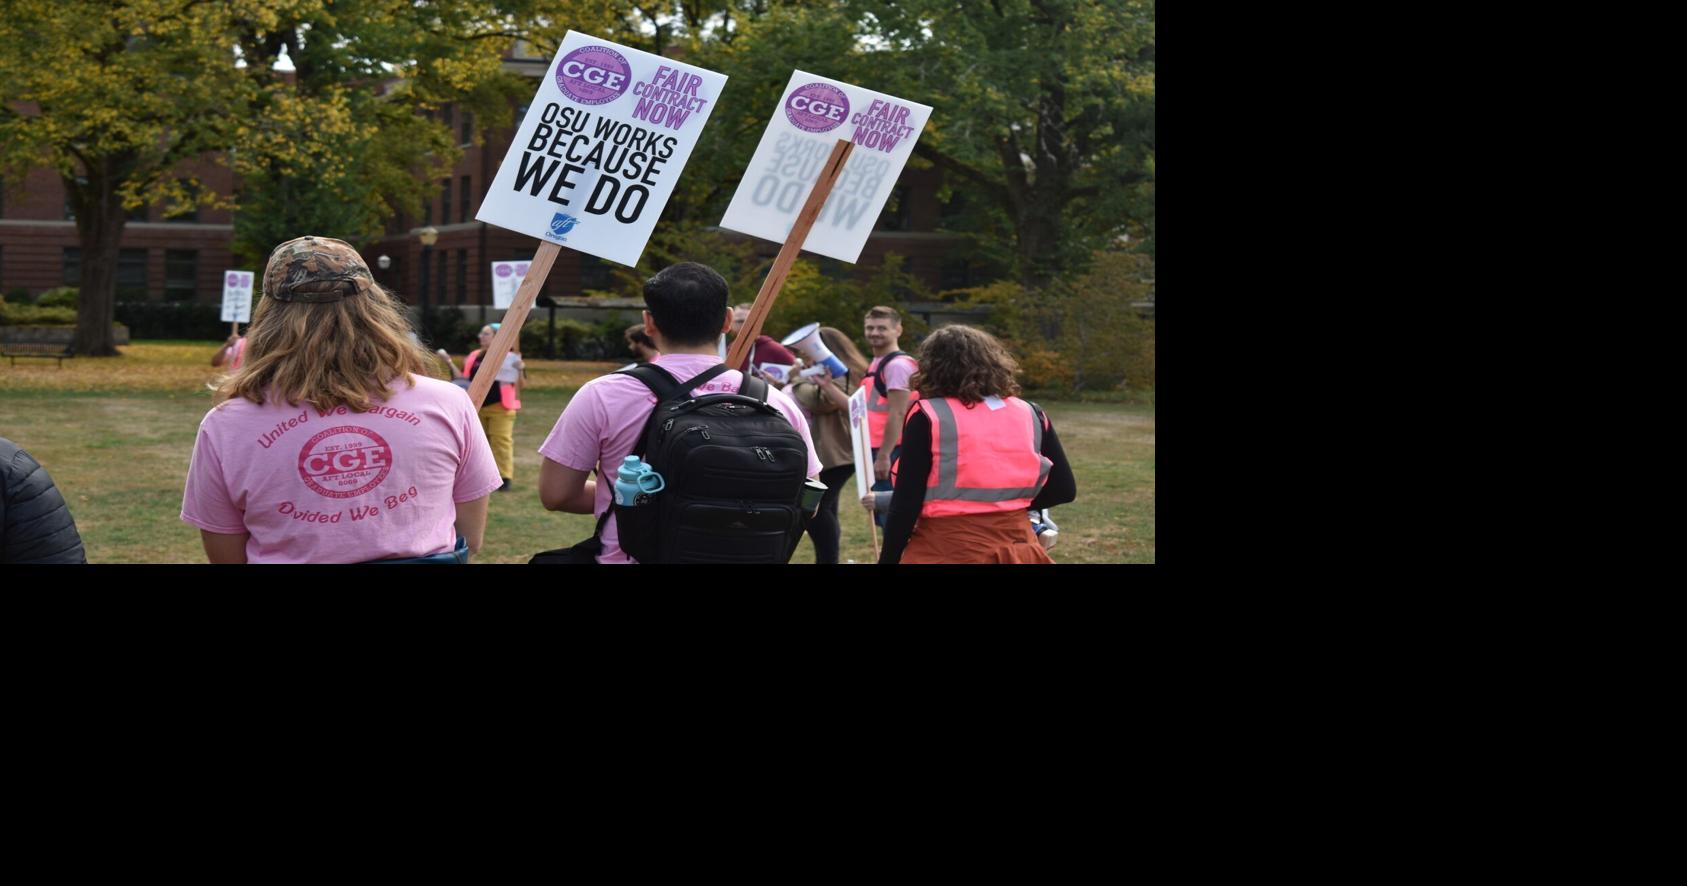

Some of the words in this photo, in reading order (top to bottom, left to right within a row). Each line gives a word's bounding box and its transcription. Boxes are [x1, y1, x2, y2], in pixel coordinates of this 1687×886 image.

[562, 60, 626, 92] CGE
[651, 65, 703, 97] FAIR
[632, 80, 708, 114] CONTRACT
[791, 95, 845, 121] CGE
[867, 99, 911, 125] FAIR
[631, 97, 691, 131] NOW
[851, 112, 915, 140] CONTRACT
[540, 102, 591, 133] OSU
[593, 116, 678, 159] WORKS
[850, 127, 901, 154] NOW
[527, 122, 667, 187] BECAUSE
[513, 151, 586, 207] WE
[584, 173, 650, 224] DO
[257, 410, 309, 449] United
[368, 405, 421, 426] argain
[311, 426, 359, 444] COALITION
[303, 446, 386, 476] CGE
[350, 505, 379, 521] We
[384, 486, 418, 509] Beg
